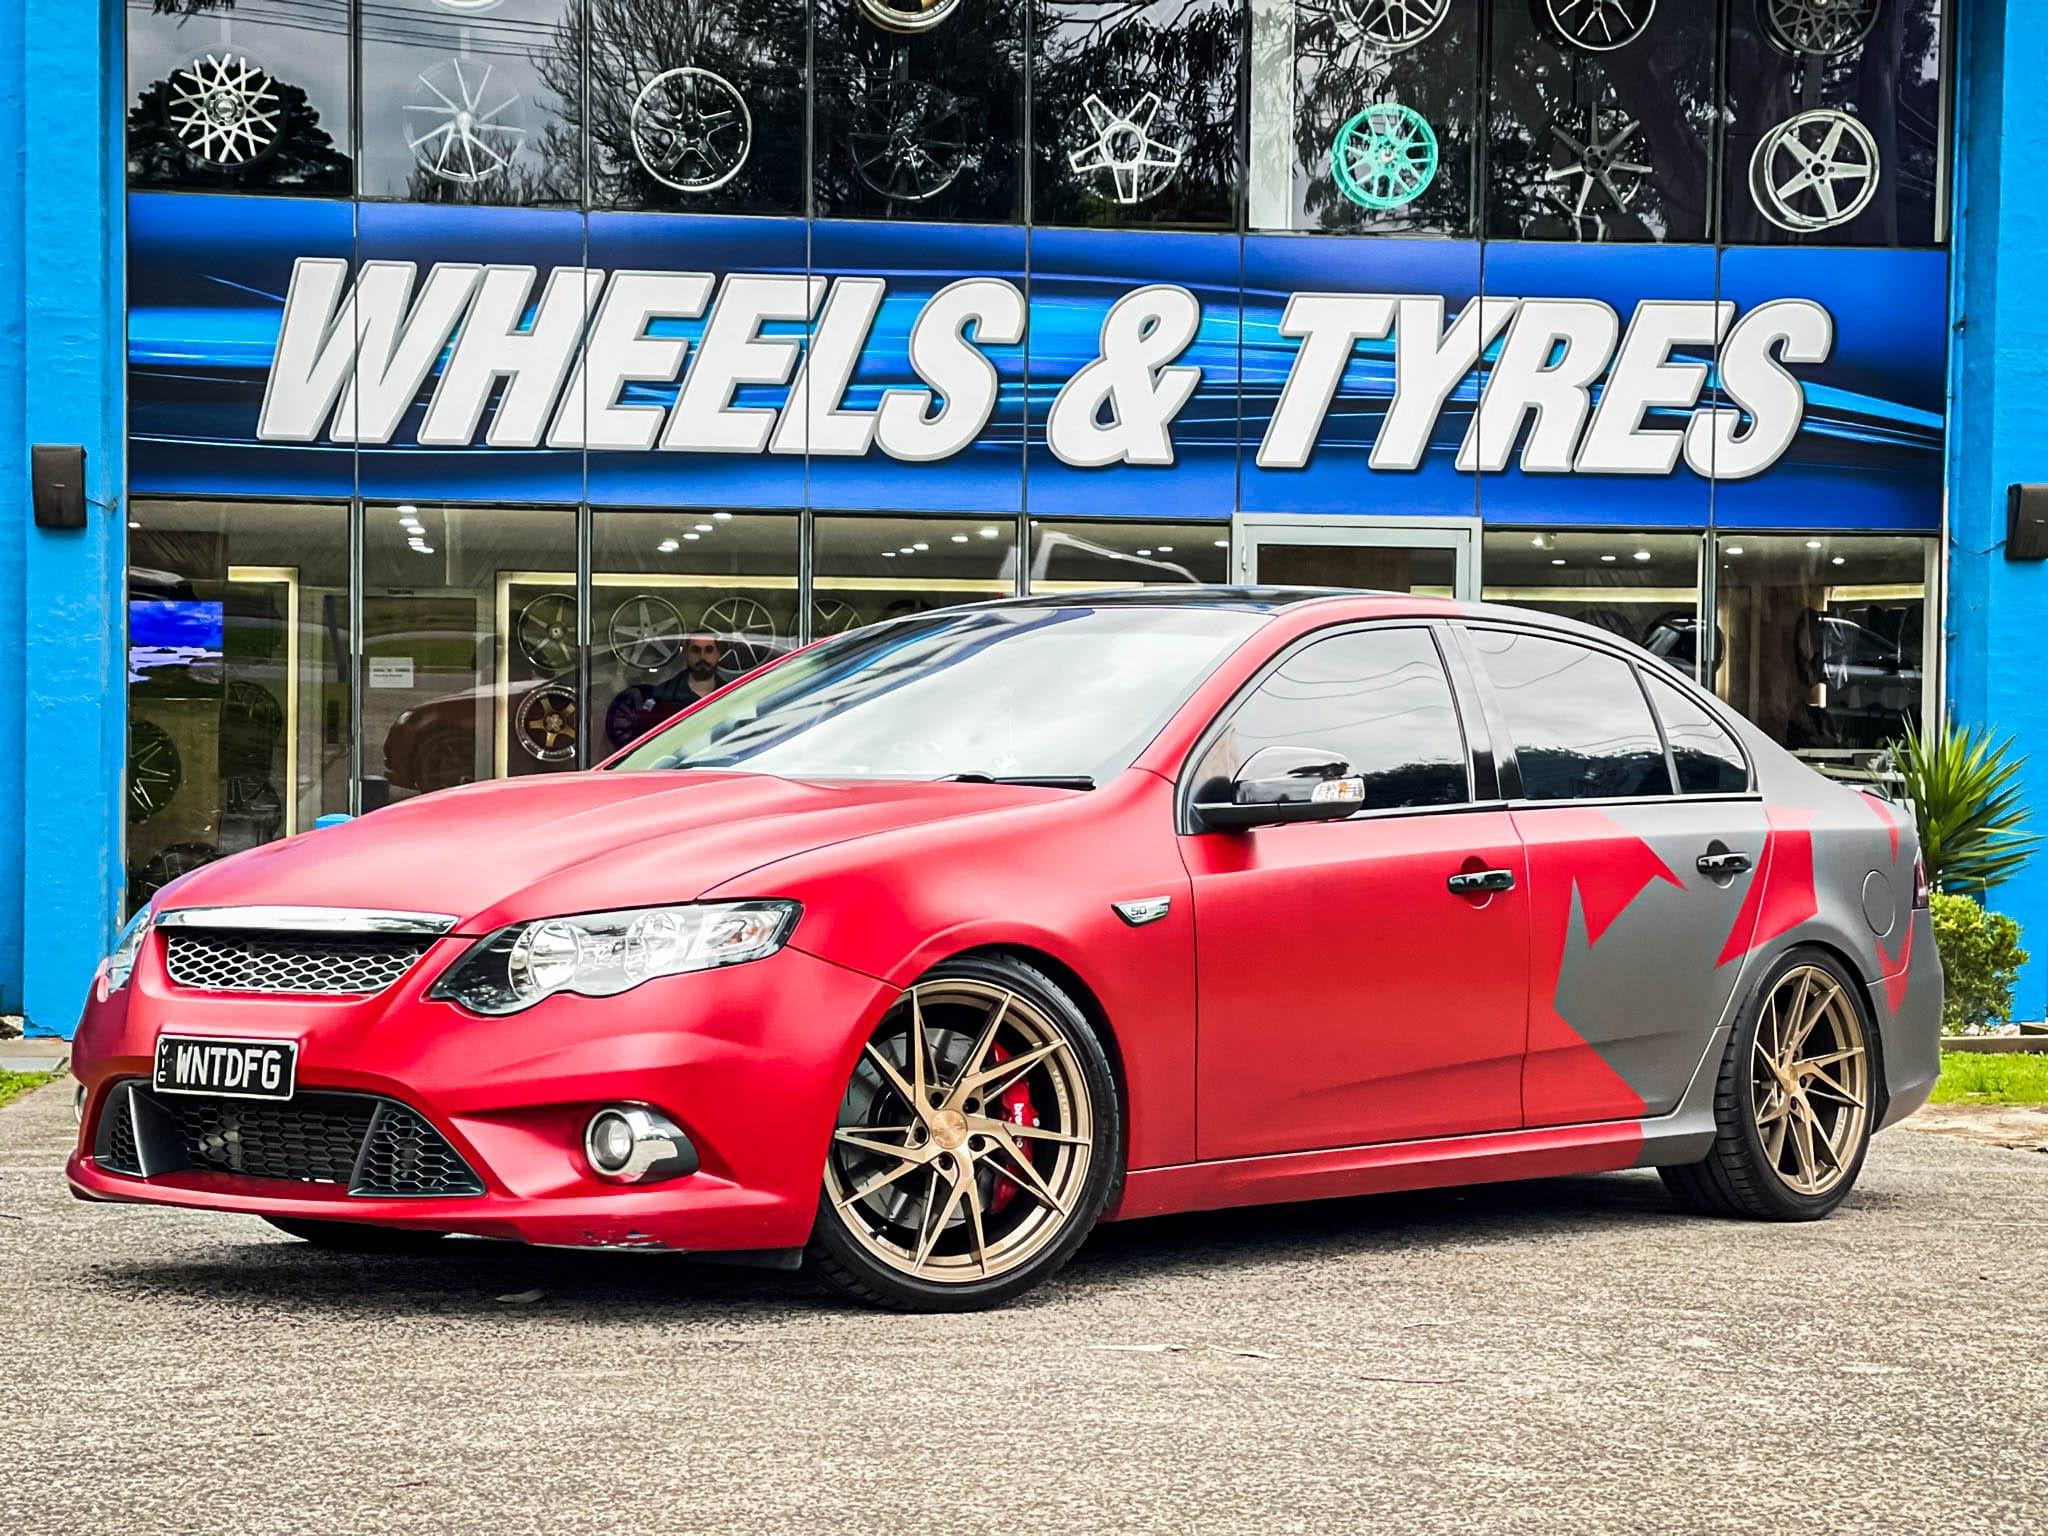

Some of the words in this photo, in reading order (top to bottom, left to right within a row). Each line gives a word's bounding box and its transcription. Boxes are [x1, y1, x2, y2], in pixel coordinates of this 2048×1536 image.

[256, 257, 1026, 462] WHEELS
[1047, 284, 1201, 466] &
[1254, 291, 1834, 479] TYRES
[157, 1045, 168, 1082] VIC
[176, 1045, 282, 1089] WNTDFG
